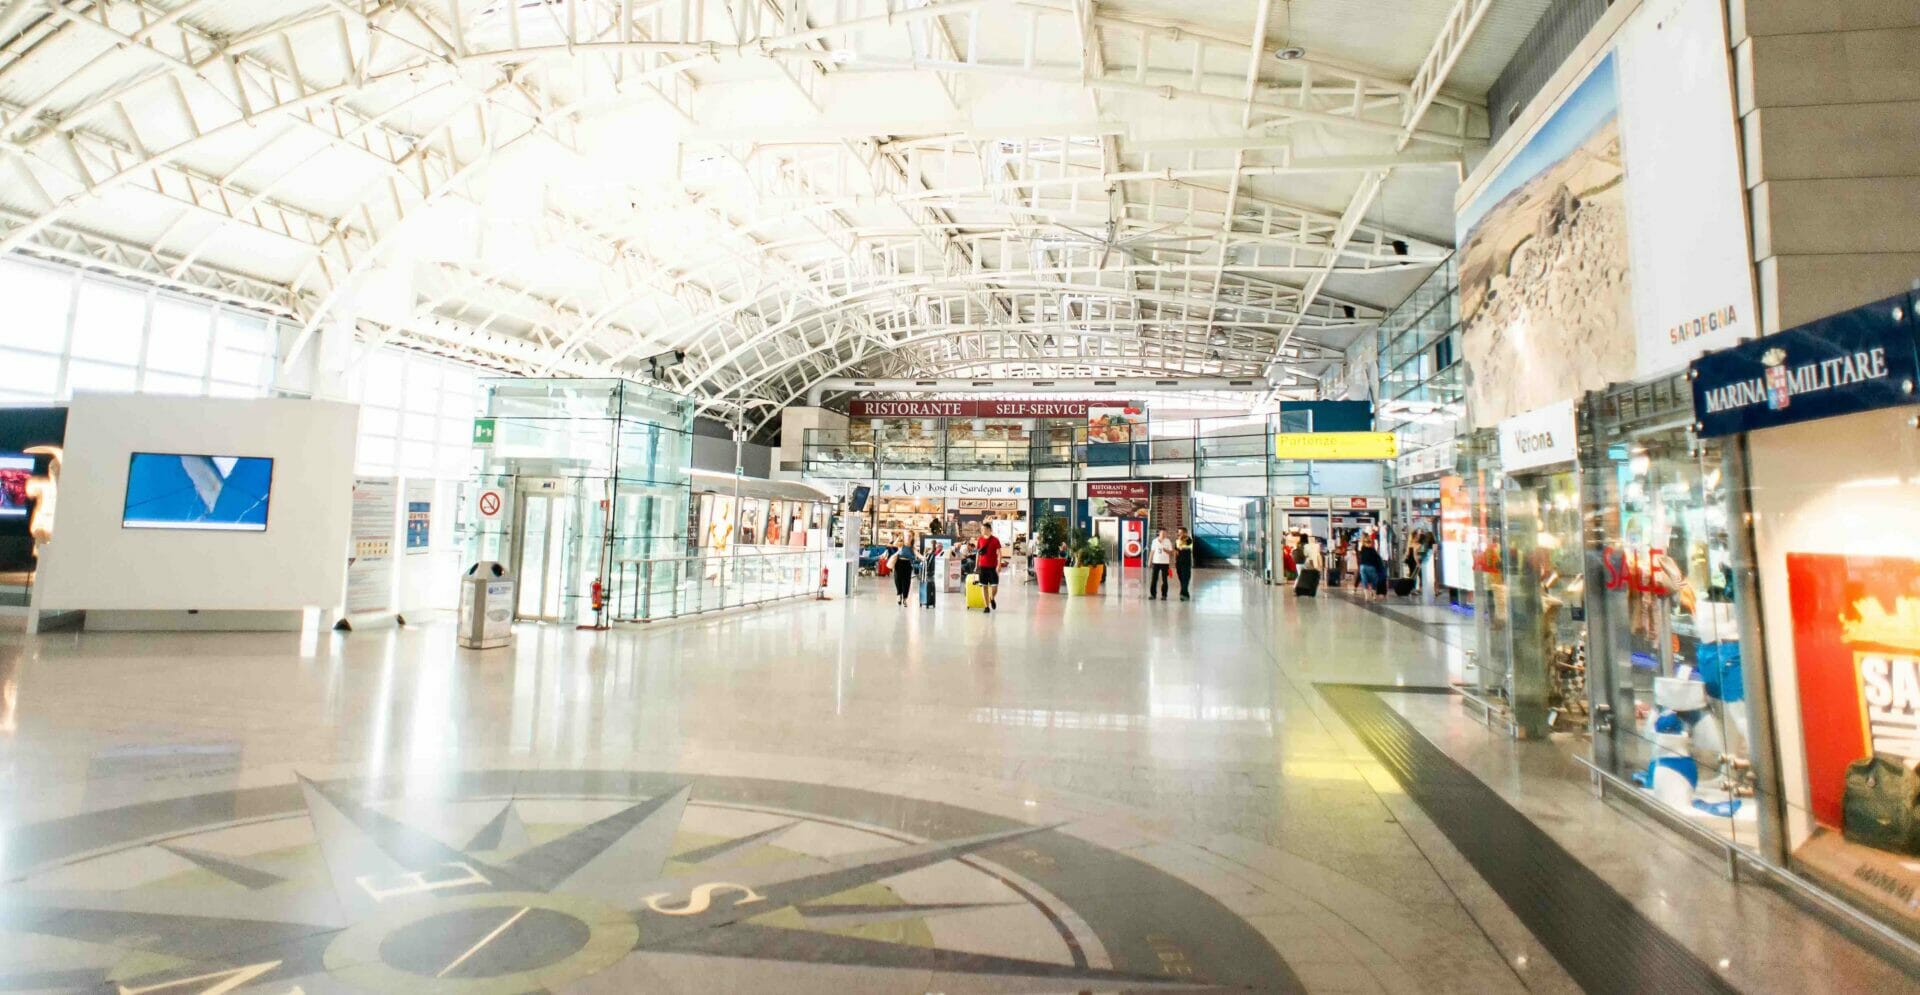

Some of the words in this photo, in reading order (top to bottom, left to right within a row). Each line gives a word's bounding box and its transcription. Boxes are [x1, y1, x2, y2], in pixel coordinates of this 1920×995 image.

[1703, 376, 1768, 414] MARINA
[1786, 347, 1889, 396] MILITARE
[864, 402, 962, 416] RISTORANTE
[996, 403, 1087, 416] SELF-SERVICE
[959, 482, 1002, 496] Sardegna
[1602, 545, 1671, 598] SALE
